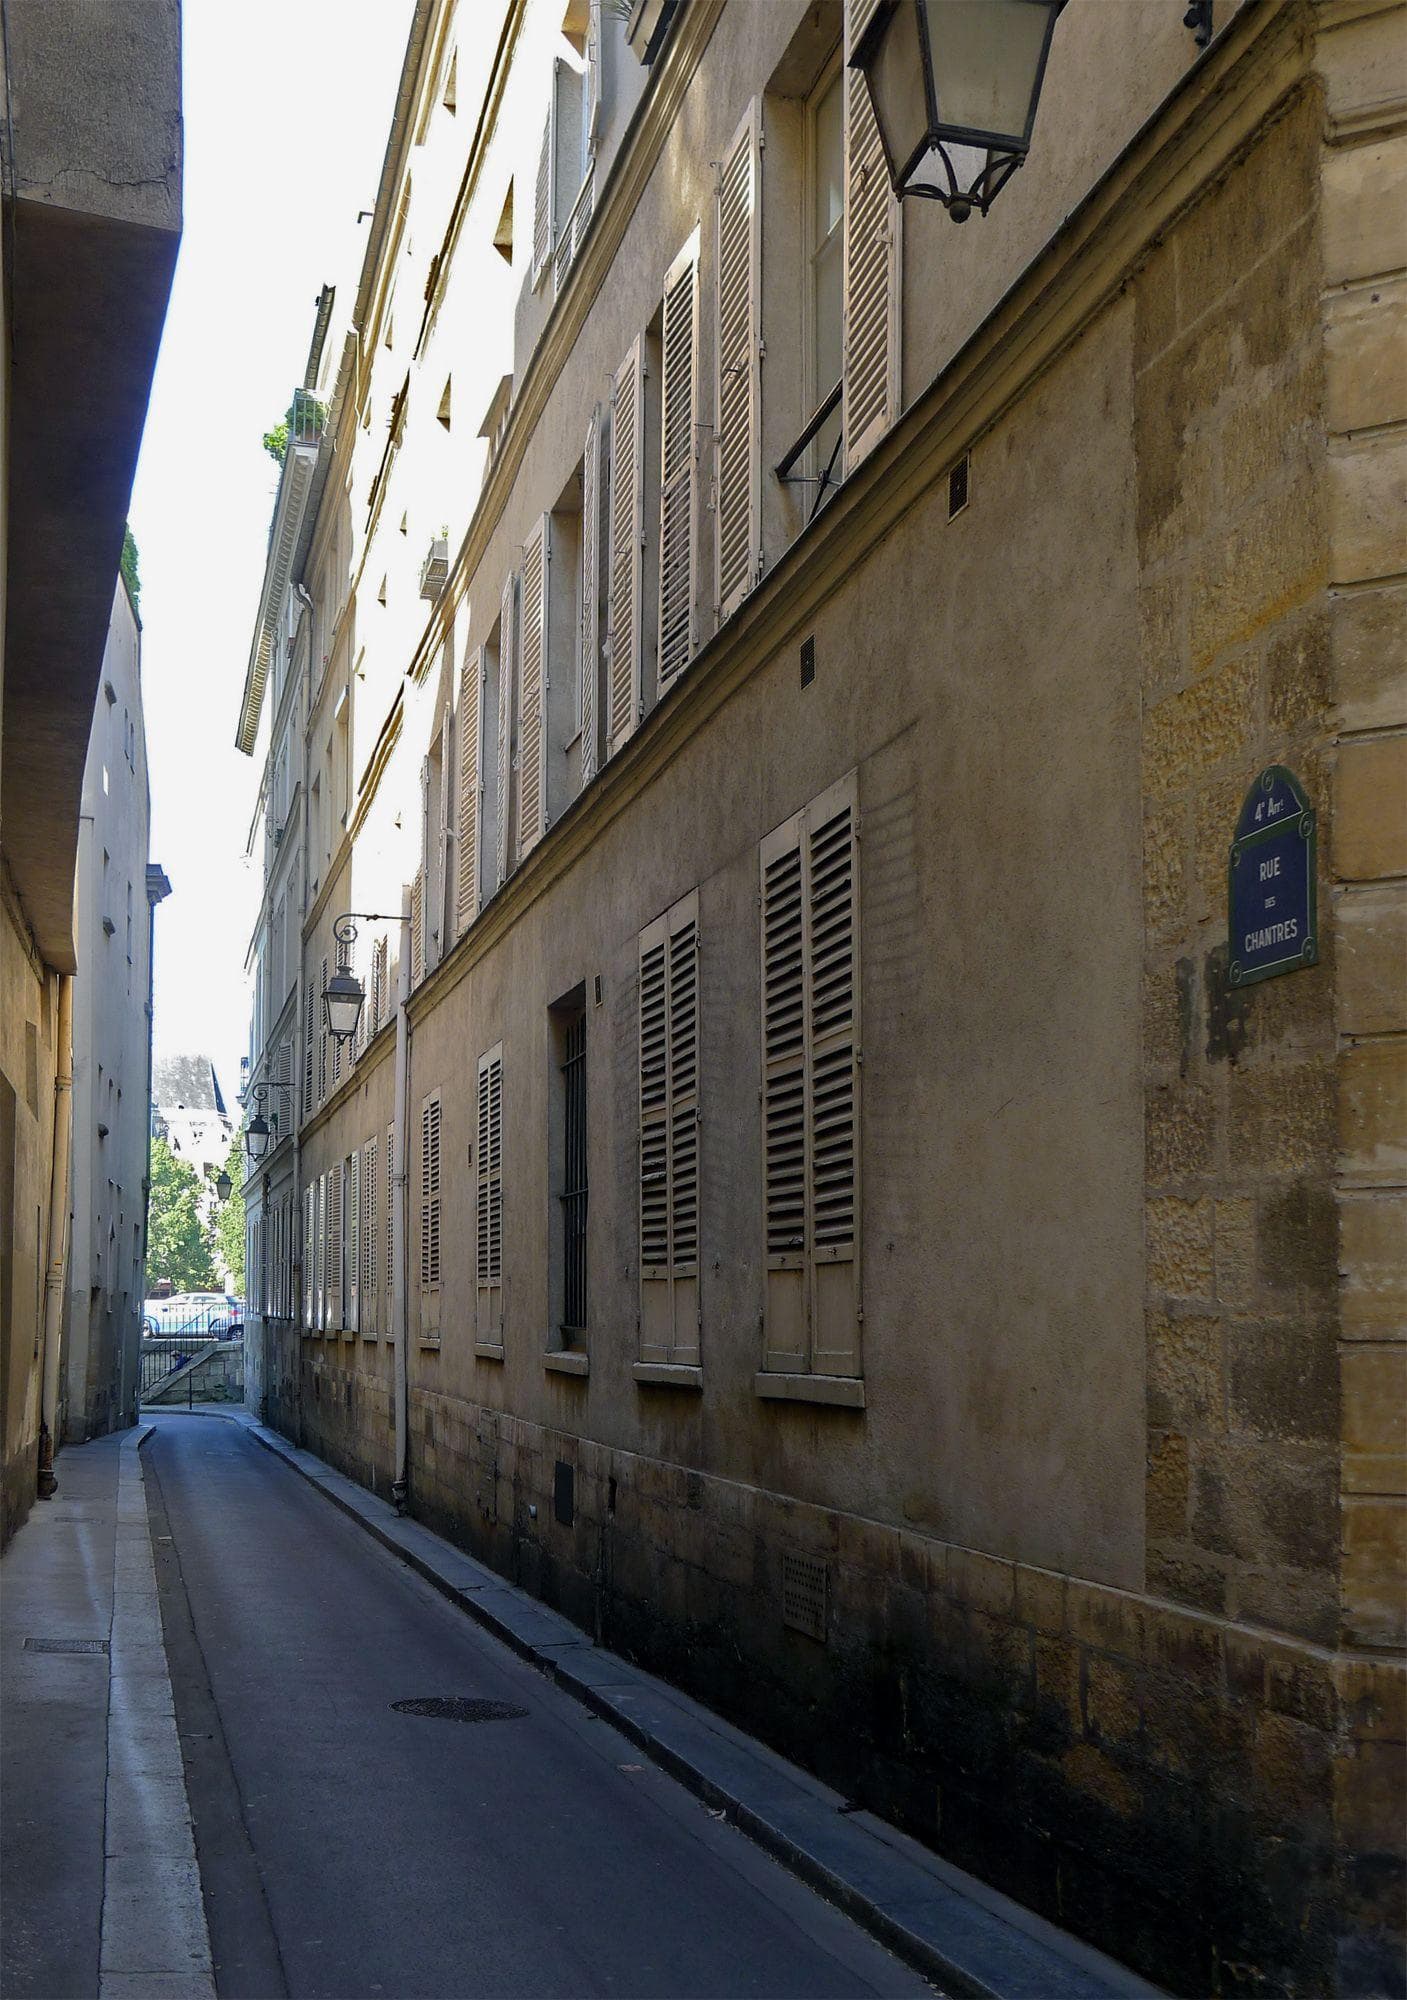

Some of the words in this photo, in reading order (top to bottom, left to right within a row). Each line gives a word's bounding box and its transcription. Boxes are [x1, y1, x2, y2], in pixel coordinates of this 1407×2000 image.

[1260, 856, 1280, 882] RUE
[1264, 896, 1276, 909] DES
[1245, 918, 1297, 952] CHANTRES
